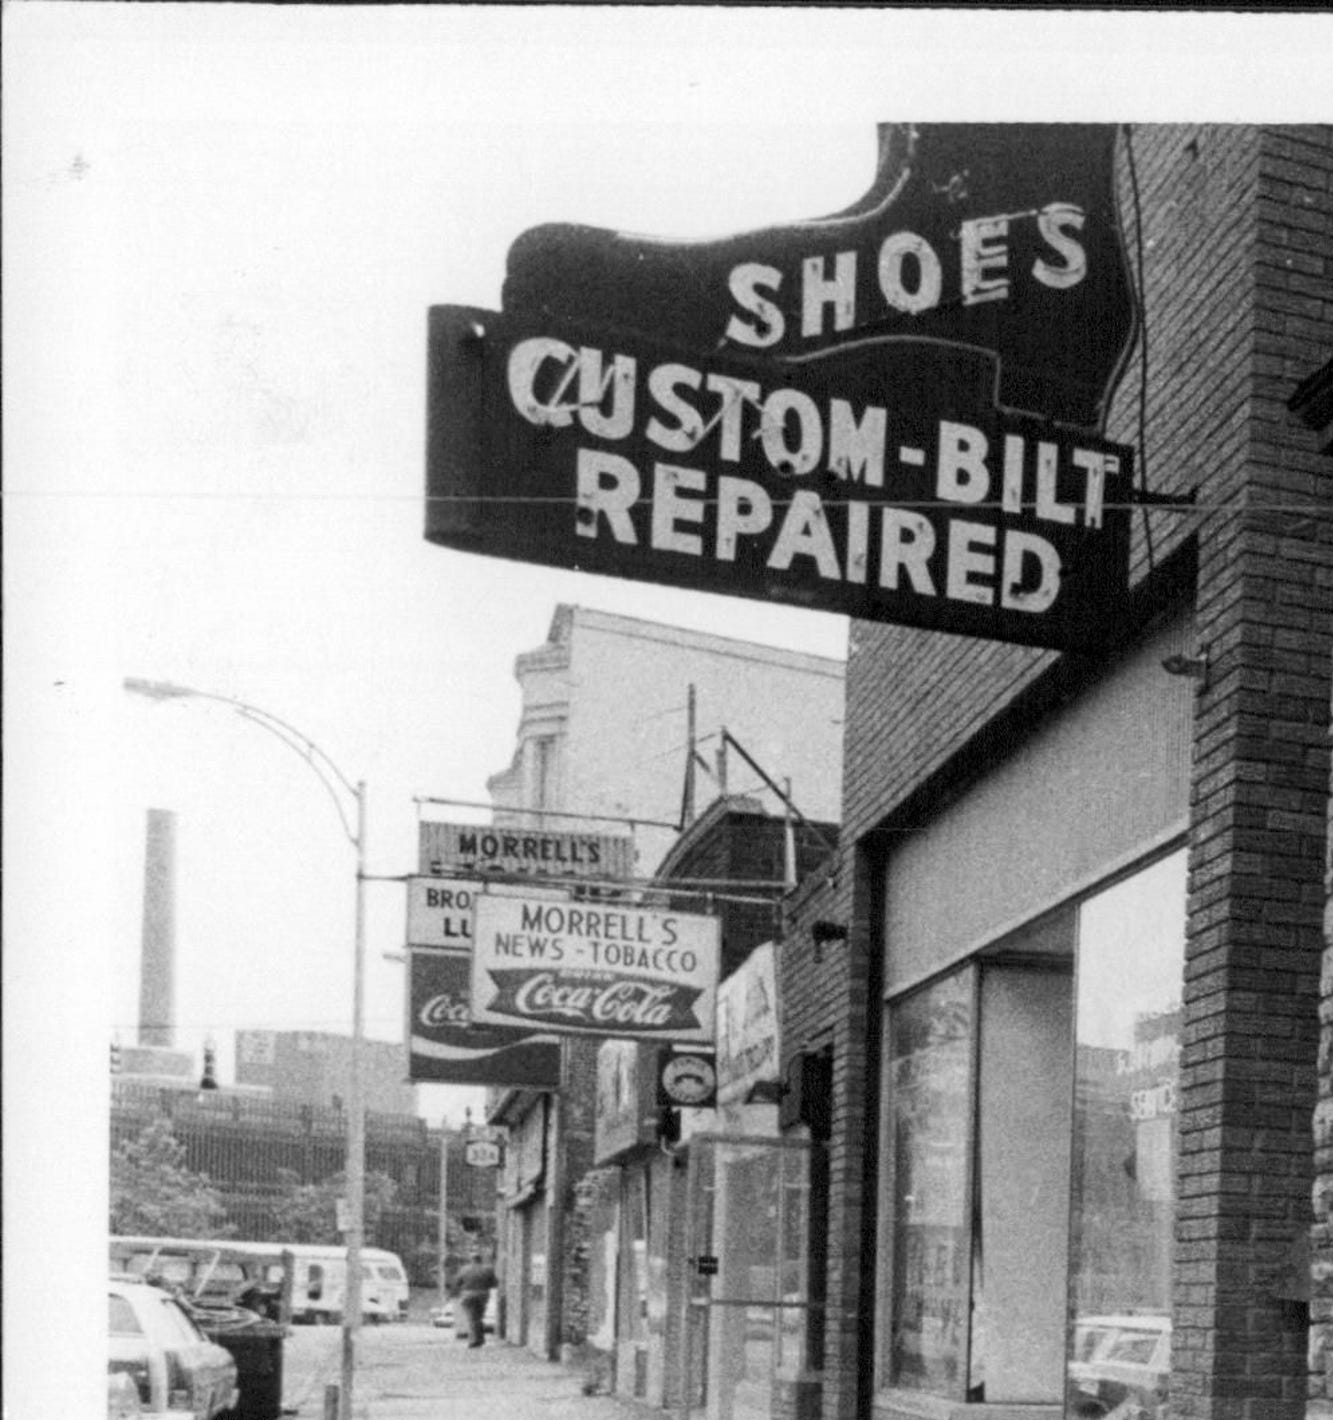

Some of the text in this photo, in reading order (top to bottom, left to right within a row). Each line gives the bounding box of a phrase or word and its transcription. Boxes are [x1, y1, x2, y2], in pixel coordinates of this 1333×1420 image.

[725, 200, 1087, 348] SHOES
[507, 337, 1120, 530] CUSTOM-BILT
[574, 448, 1062, 615] REPAIRED
[458, 833, 601, 864] MORRELL'S
[426, 887, 473, 910] BRO
[520, 902, 679, 945] MORRELL'S
[494, 932, 564, 961] NEWS
[591, 940, 697, 973] TOBACCO
[514, 972, 679, 1026] Coca-Cola
